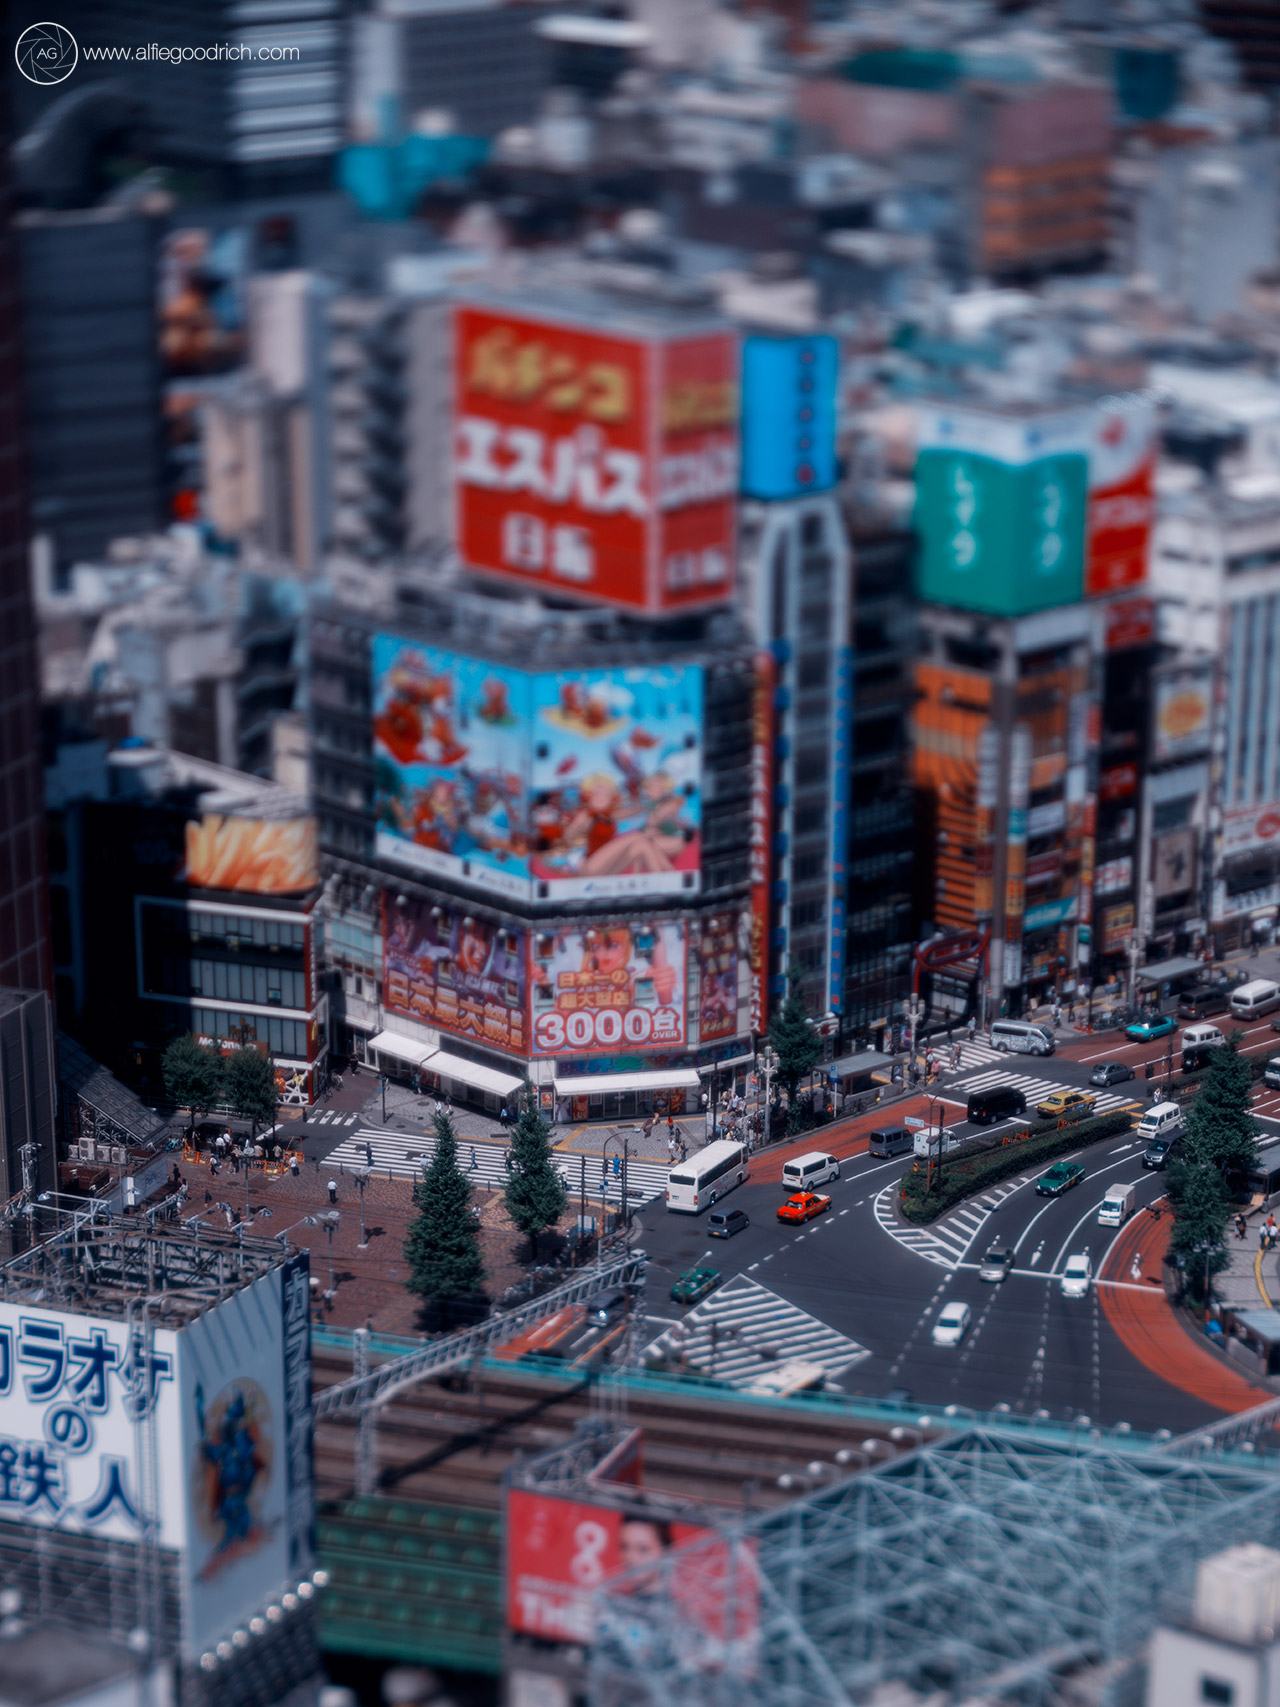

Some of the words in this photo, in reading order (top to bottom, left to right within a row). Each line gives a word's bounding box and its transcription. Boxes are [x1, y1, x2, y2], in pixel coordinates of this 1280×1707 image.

[457, 417, 653, 519] エスパス
[558, 970, 629, 989] 日本一の
[750, 974, 763, 1033] エスパス
[651, 1030, 678, 1039] OVER
[0, 1315, 174, 1424] ラオケ
[43, 1400, 94, 1457] の
[0, 1433, 160, 1530] 鉄人
